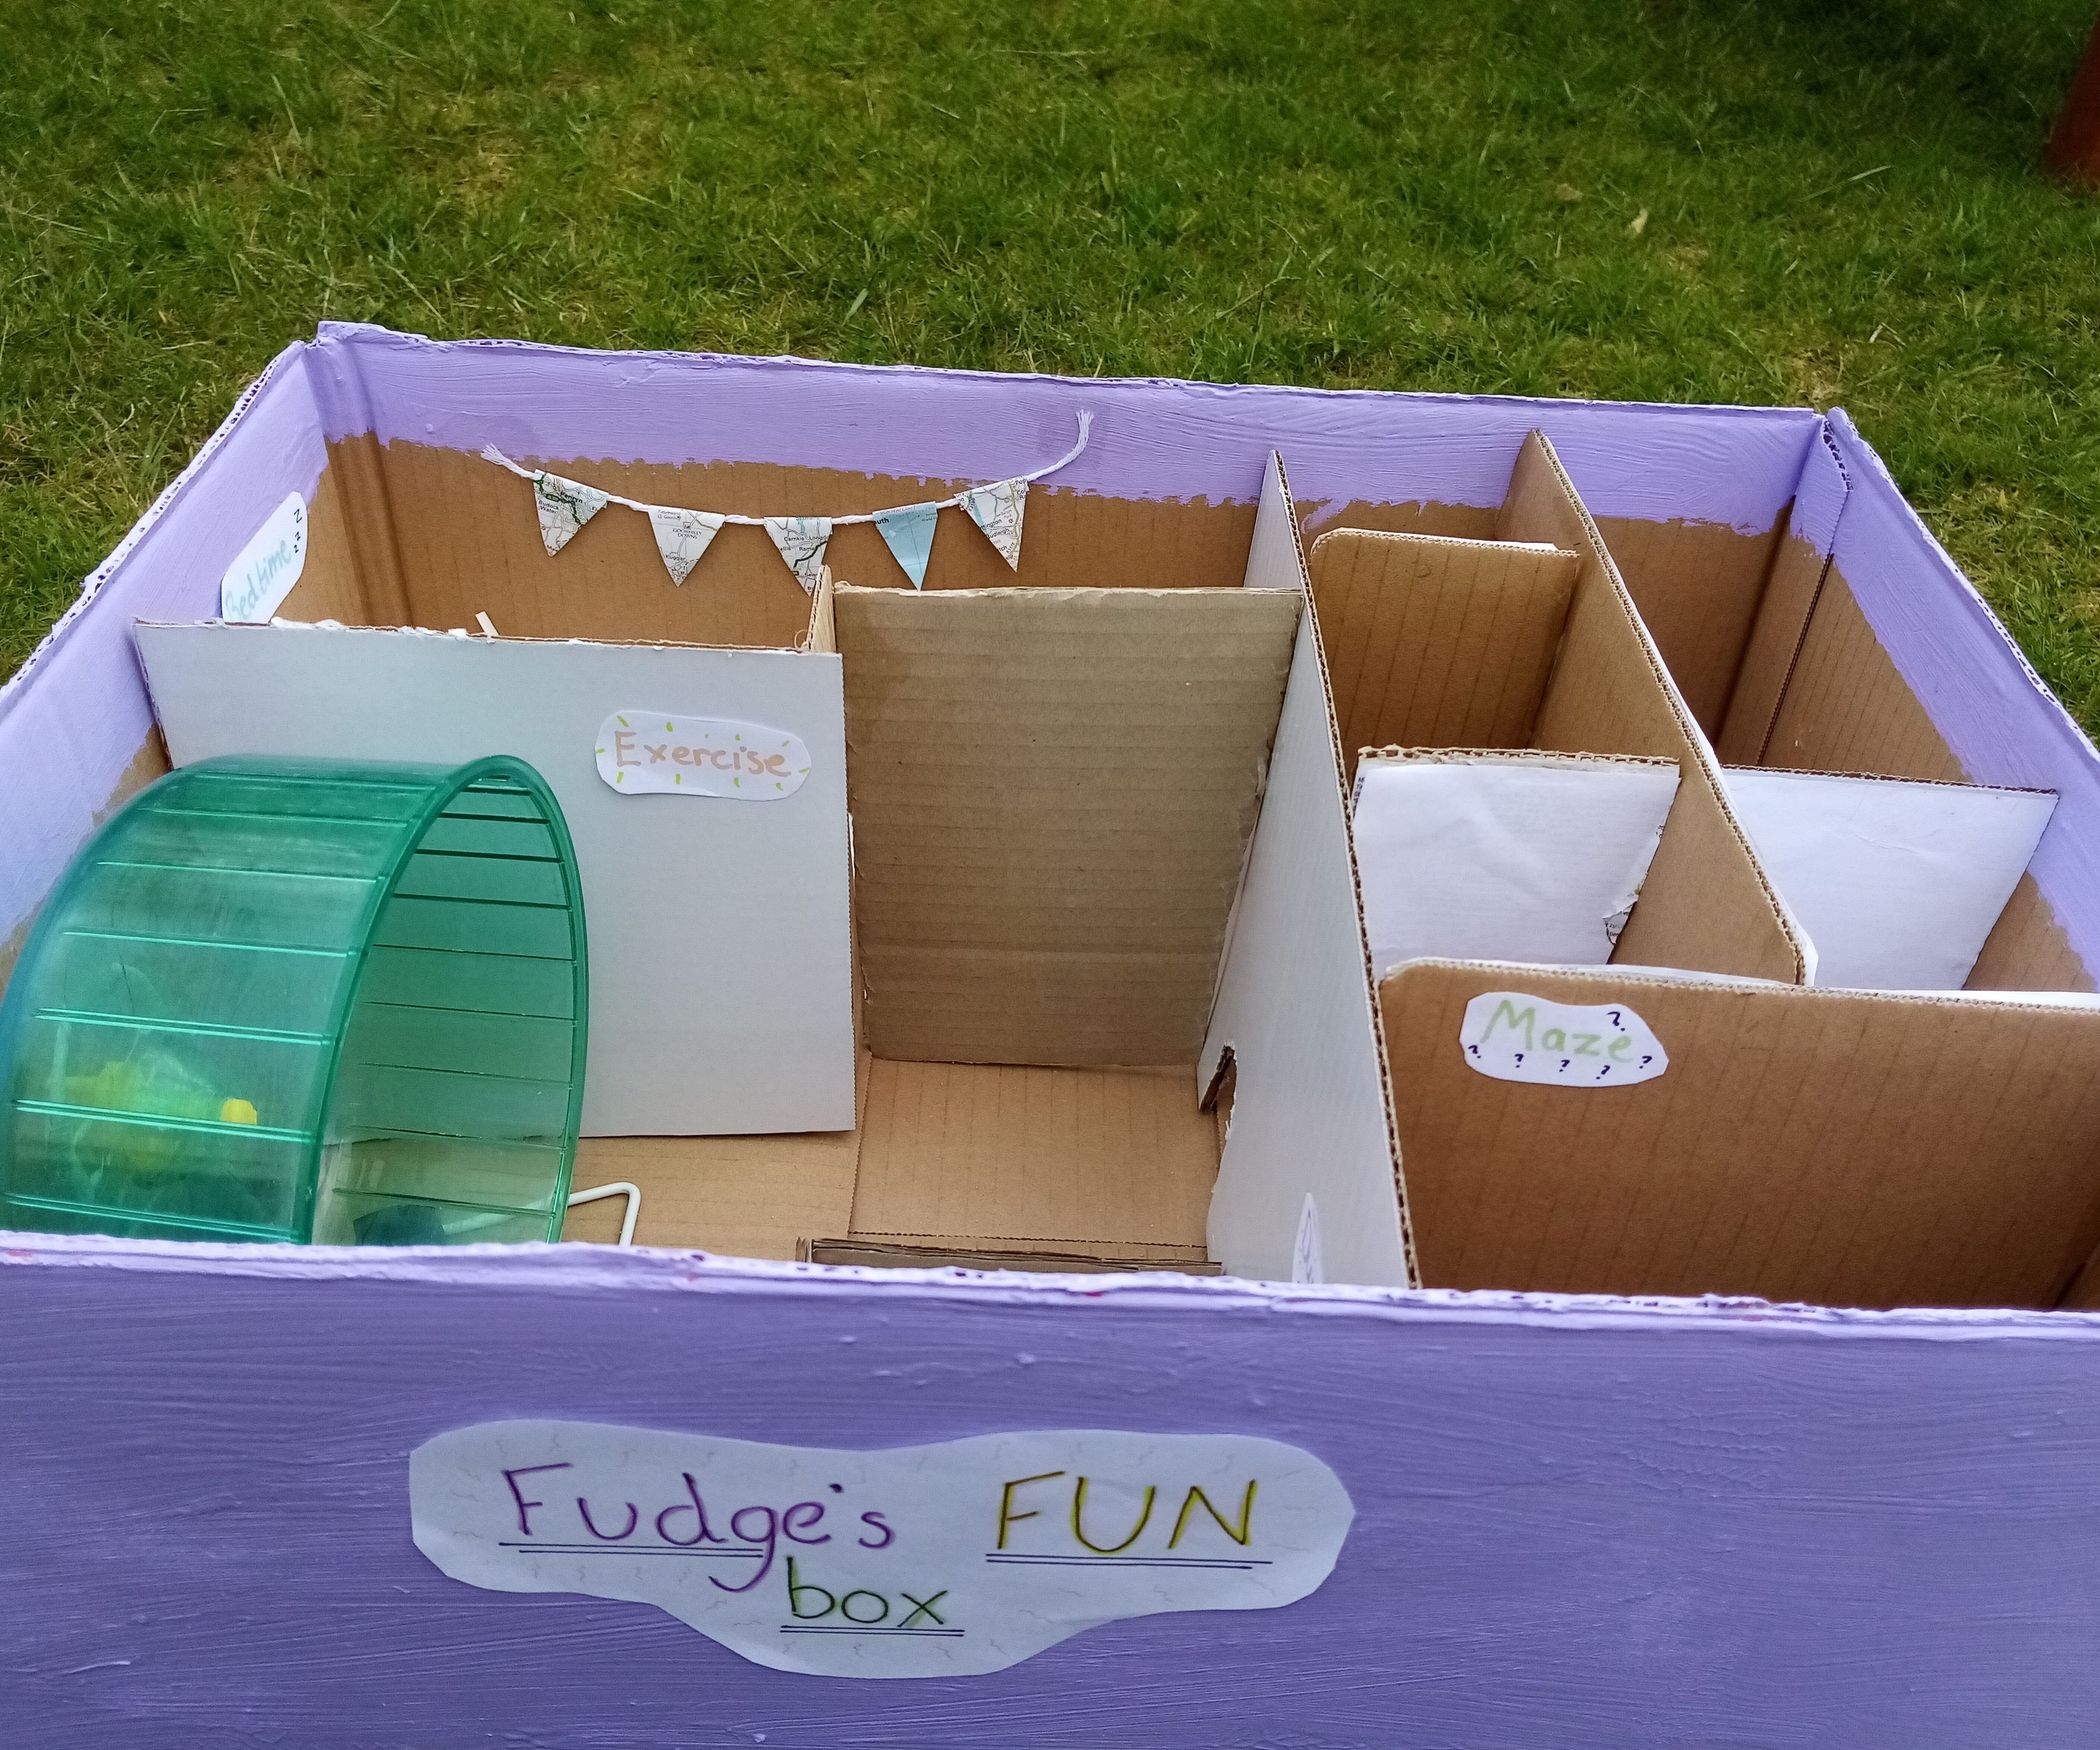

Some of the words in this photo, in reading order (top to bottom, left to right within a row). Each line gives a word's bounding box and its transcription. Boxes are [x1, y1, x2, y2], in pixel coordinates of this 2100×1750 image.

[614, 730, 792, 777] Exercise
[1479, 999, 1634, 1063] Maze
[499, 1461, 896, 1592] Fudge's
[995, 1470, 1258, 1550] FUN
[787, 1556, 946, 1628] box
